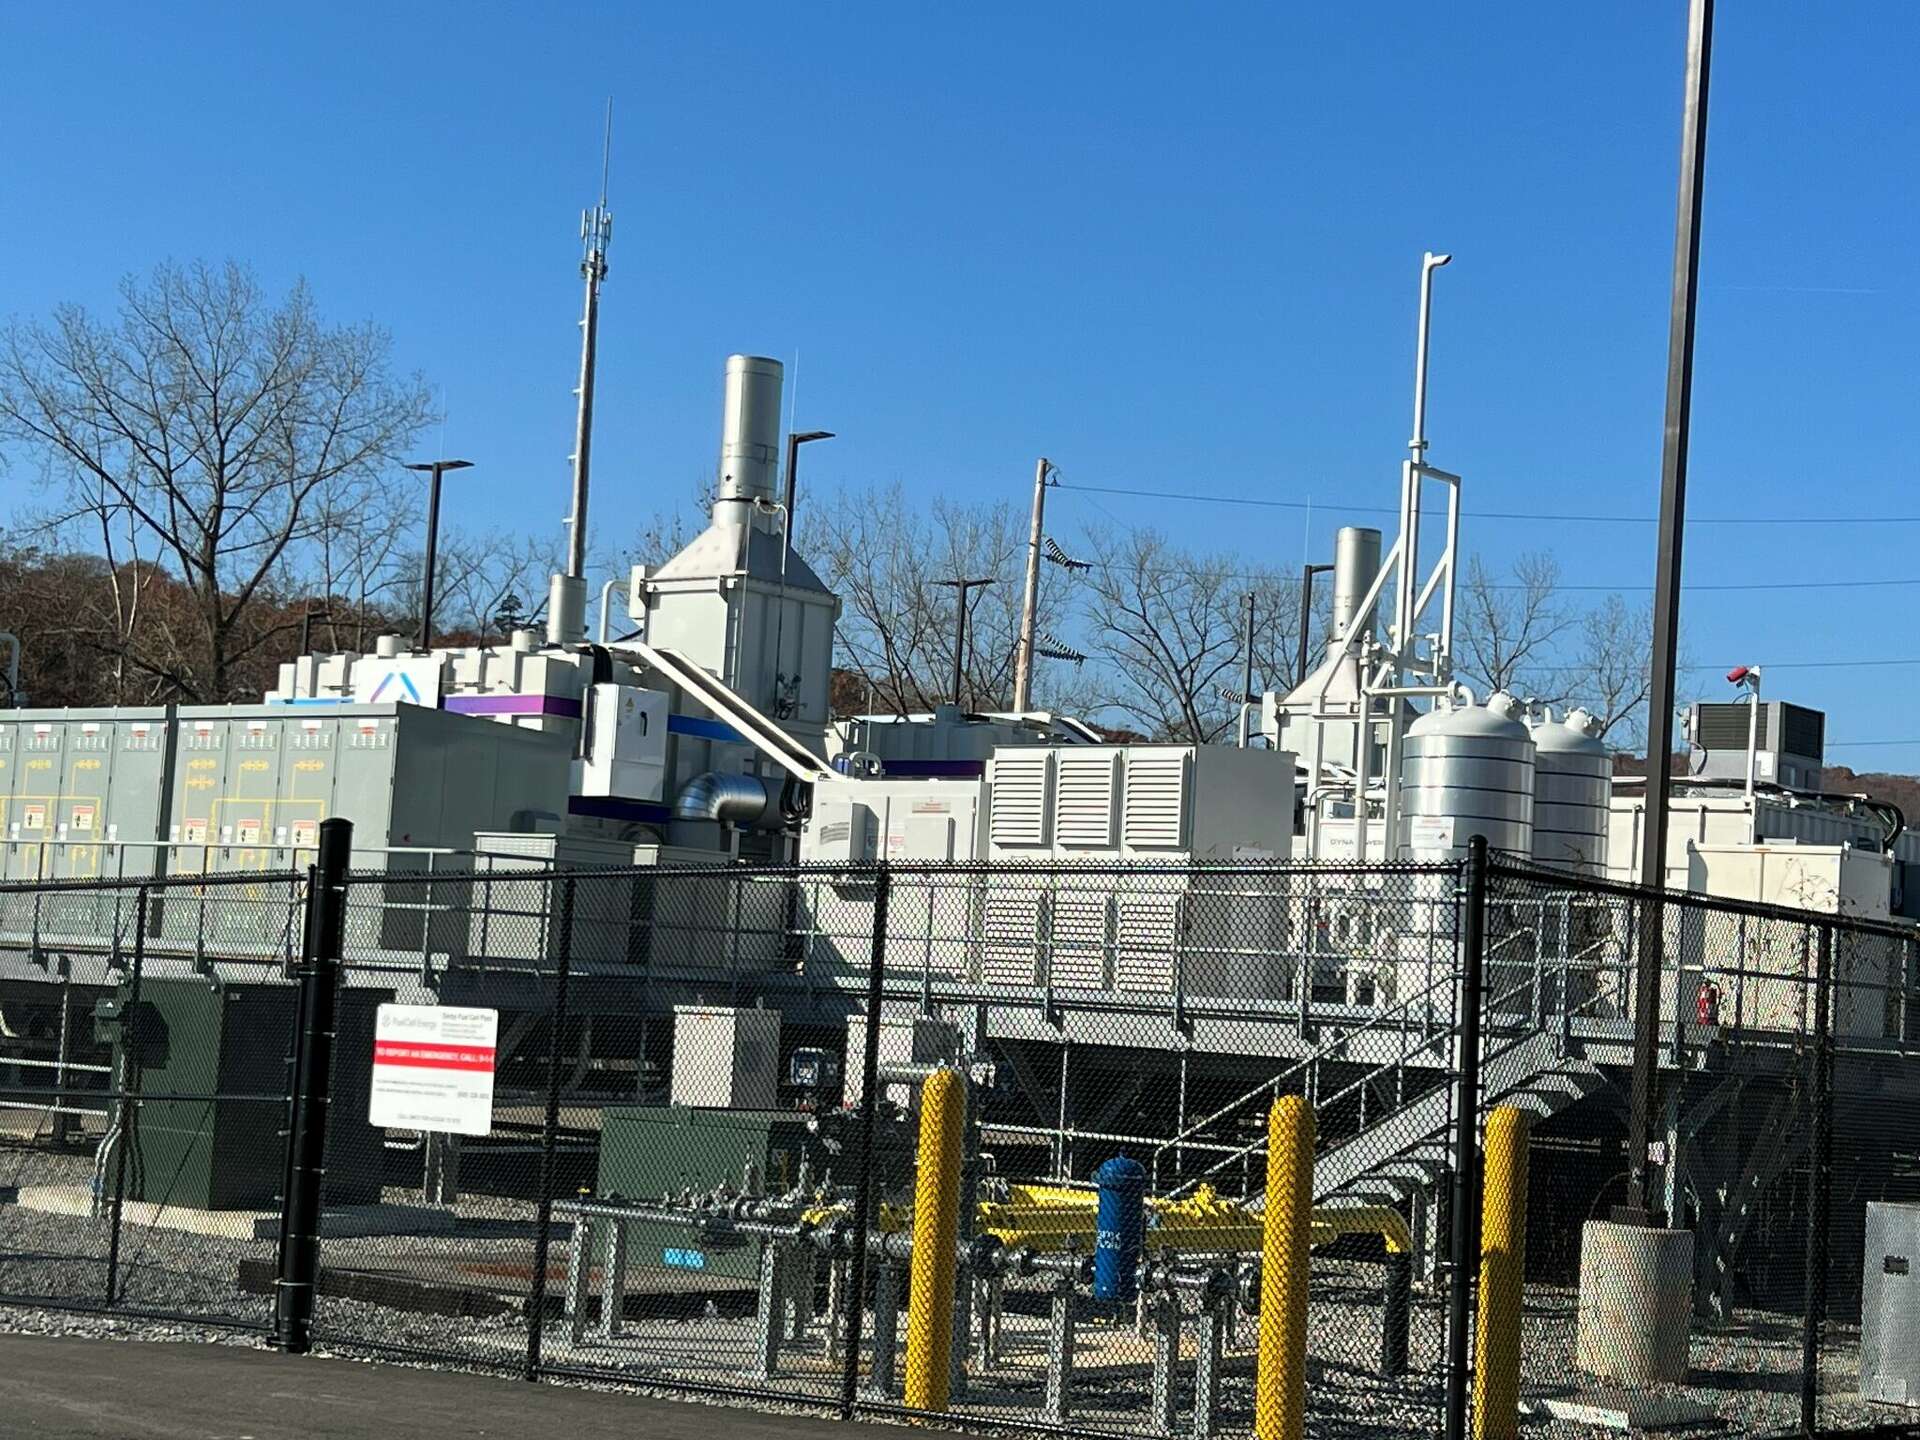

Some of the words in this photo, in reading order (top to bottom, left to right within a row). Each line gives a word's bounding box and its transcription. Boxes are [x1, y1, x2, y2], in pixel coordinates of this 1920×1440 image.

[376, 1047, 385, 1056] TO
[386, 1048, 410, 1057] REPORT
[411, 1049, 420, 1058] AN
